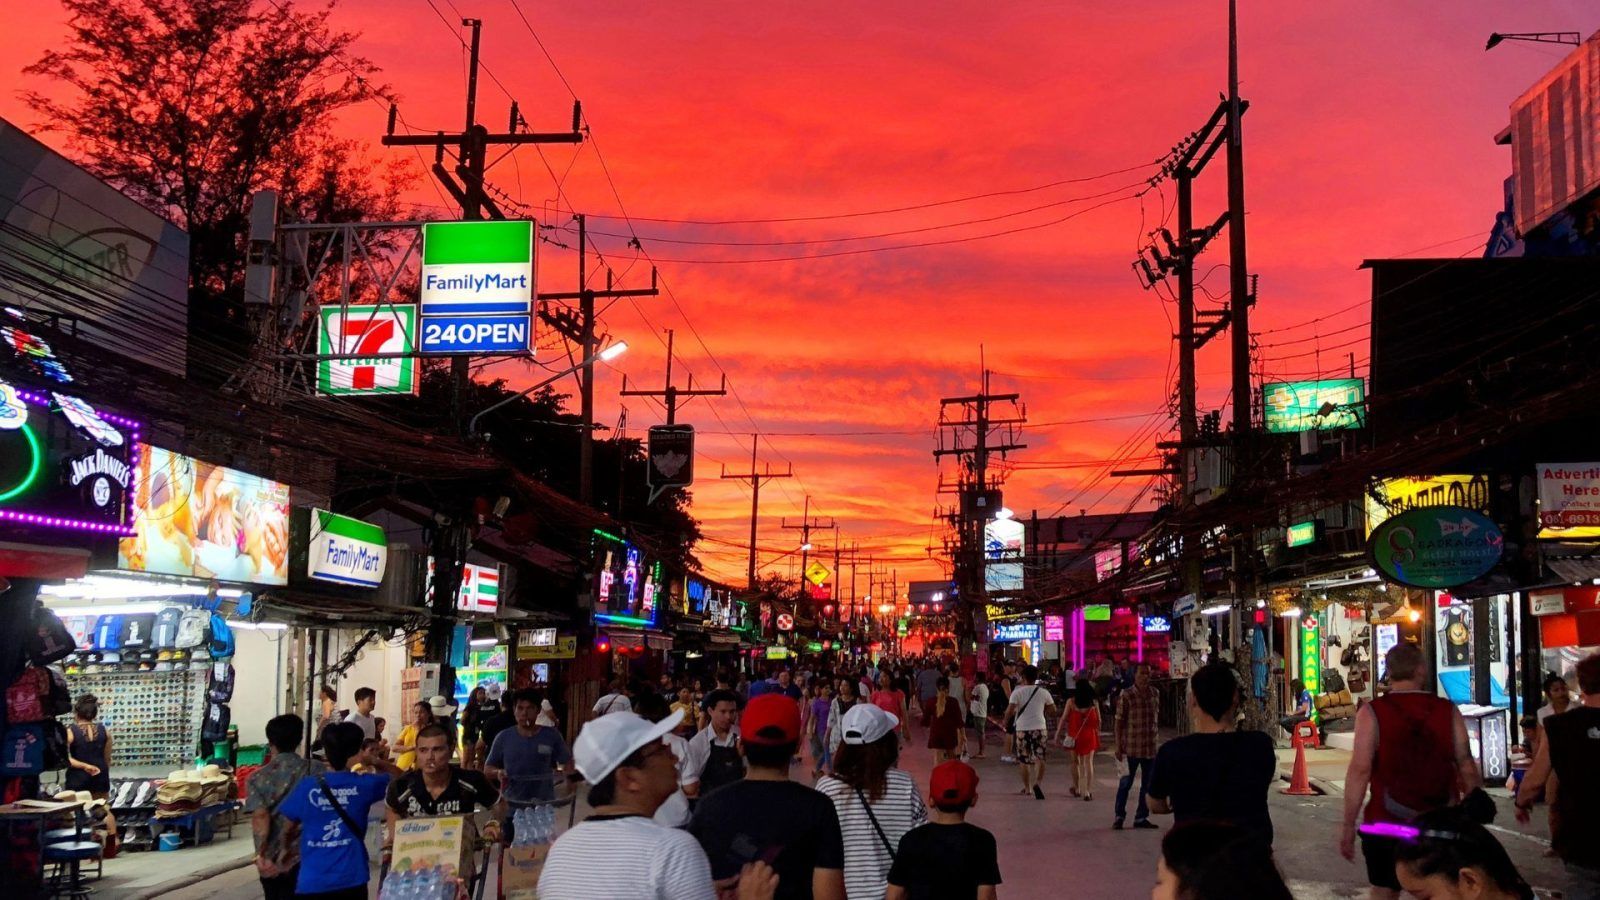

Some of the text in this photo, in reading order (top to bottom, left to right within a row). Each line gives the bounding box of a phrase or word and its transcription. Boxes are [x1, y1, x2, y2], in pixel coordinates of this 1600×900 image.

[426, 273, 527, 293] FamilyMart
[424, 322, 525, 344] 24OPEN
[342, 319, 394, 389] 7
[1563, 485, 1600, 497] Here
[326, 538, 380, 574] FamilyMart
[1000, 630, 1037, 639] PHARMACY
[1488, 718, 1501, 776] TATTOO
